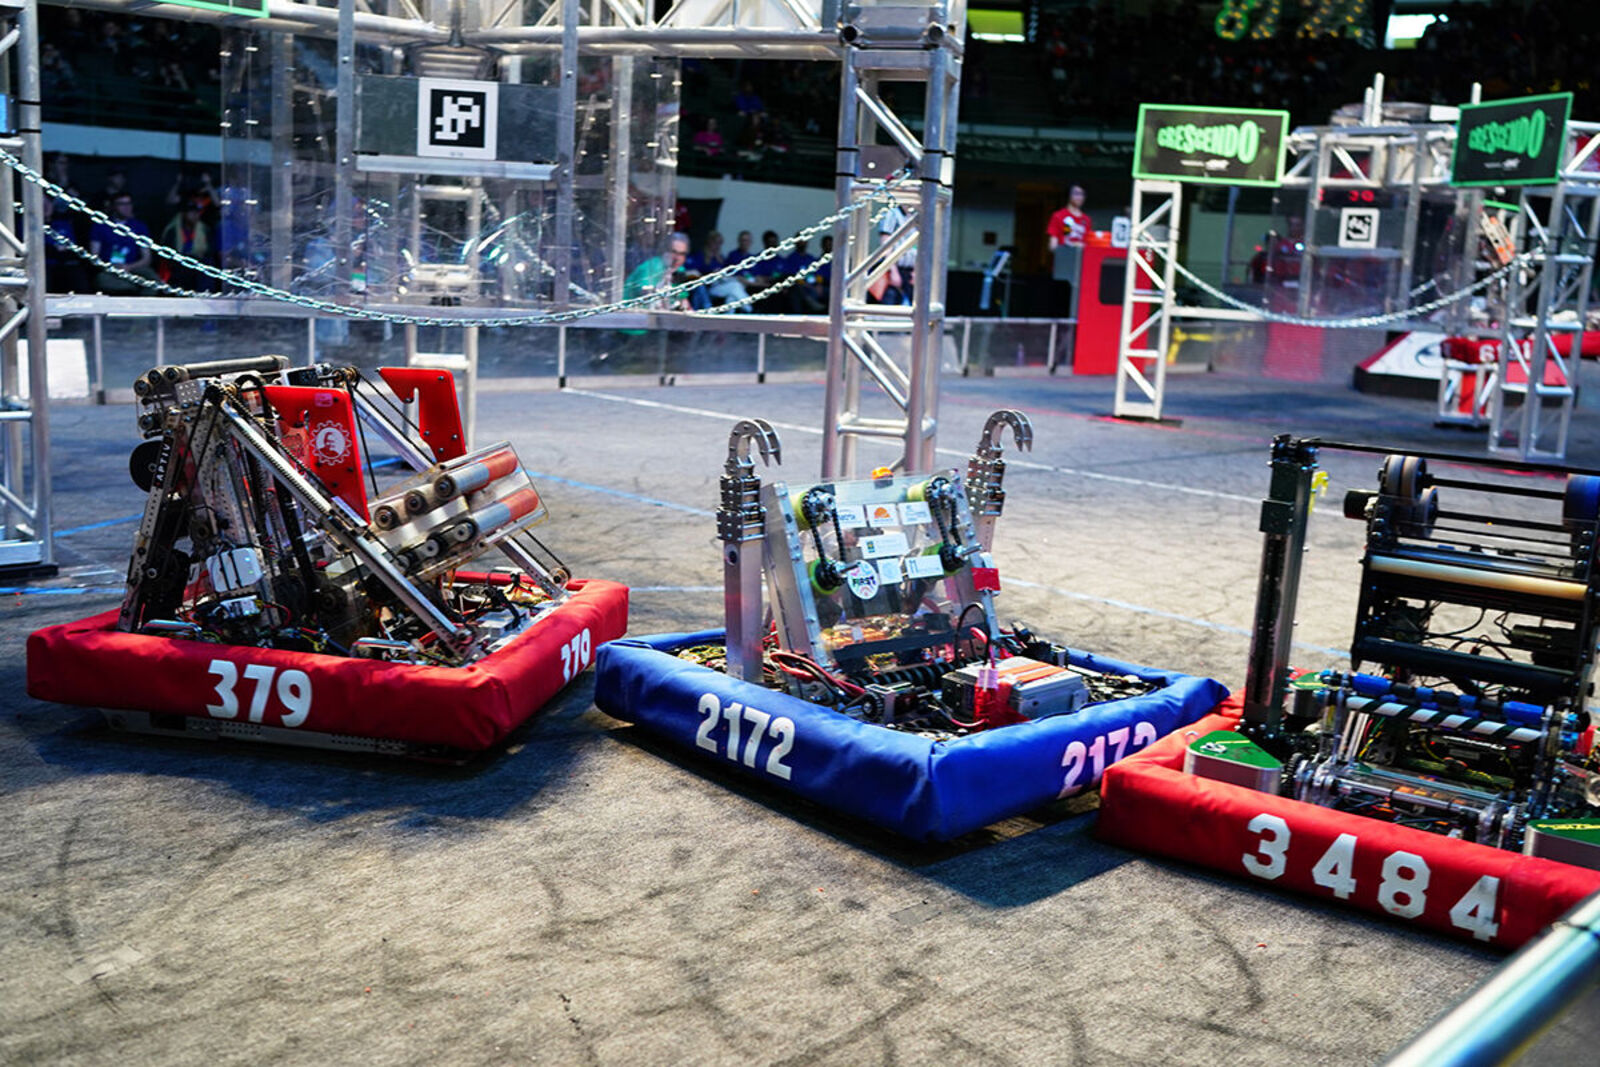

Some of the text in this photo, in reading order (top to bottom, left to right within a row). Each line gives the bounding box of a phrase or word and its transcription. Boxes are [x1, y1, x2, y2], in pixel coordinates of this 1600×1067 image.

[1157, 120, 1260, 164] CRESCENDO
[156, 443, 171, 481] APTIV
[852, 575, 877, 587] FIRST
[206, 659, 313, 728] 379
[695, 692, 796, 781] 2172
[1241, 813, 1501, 942] 3484
